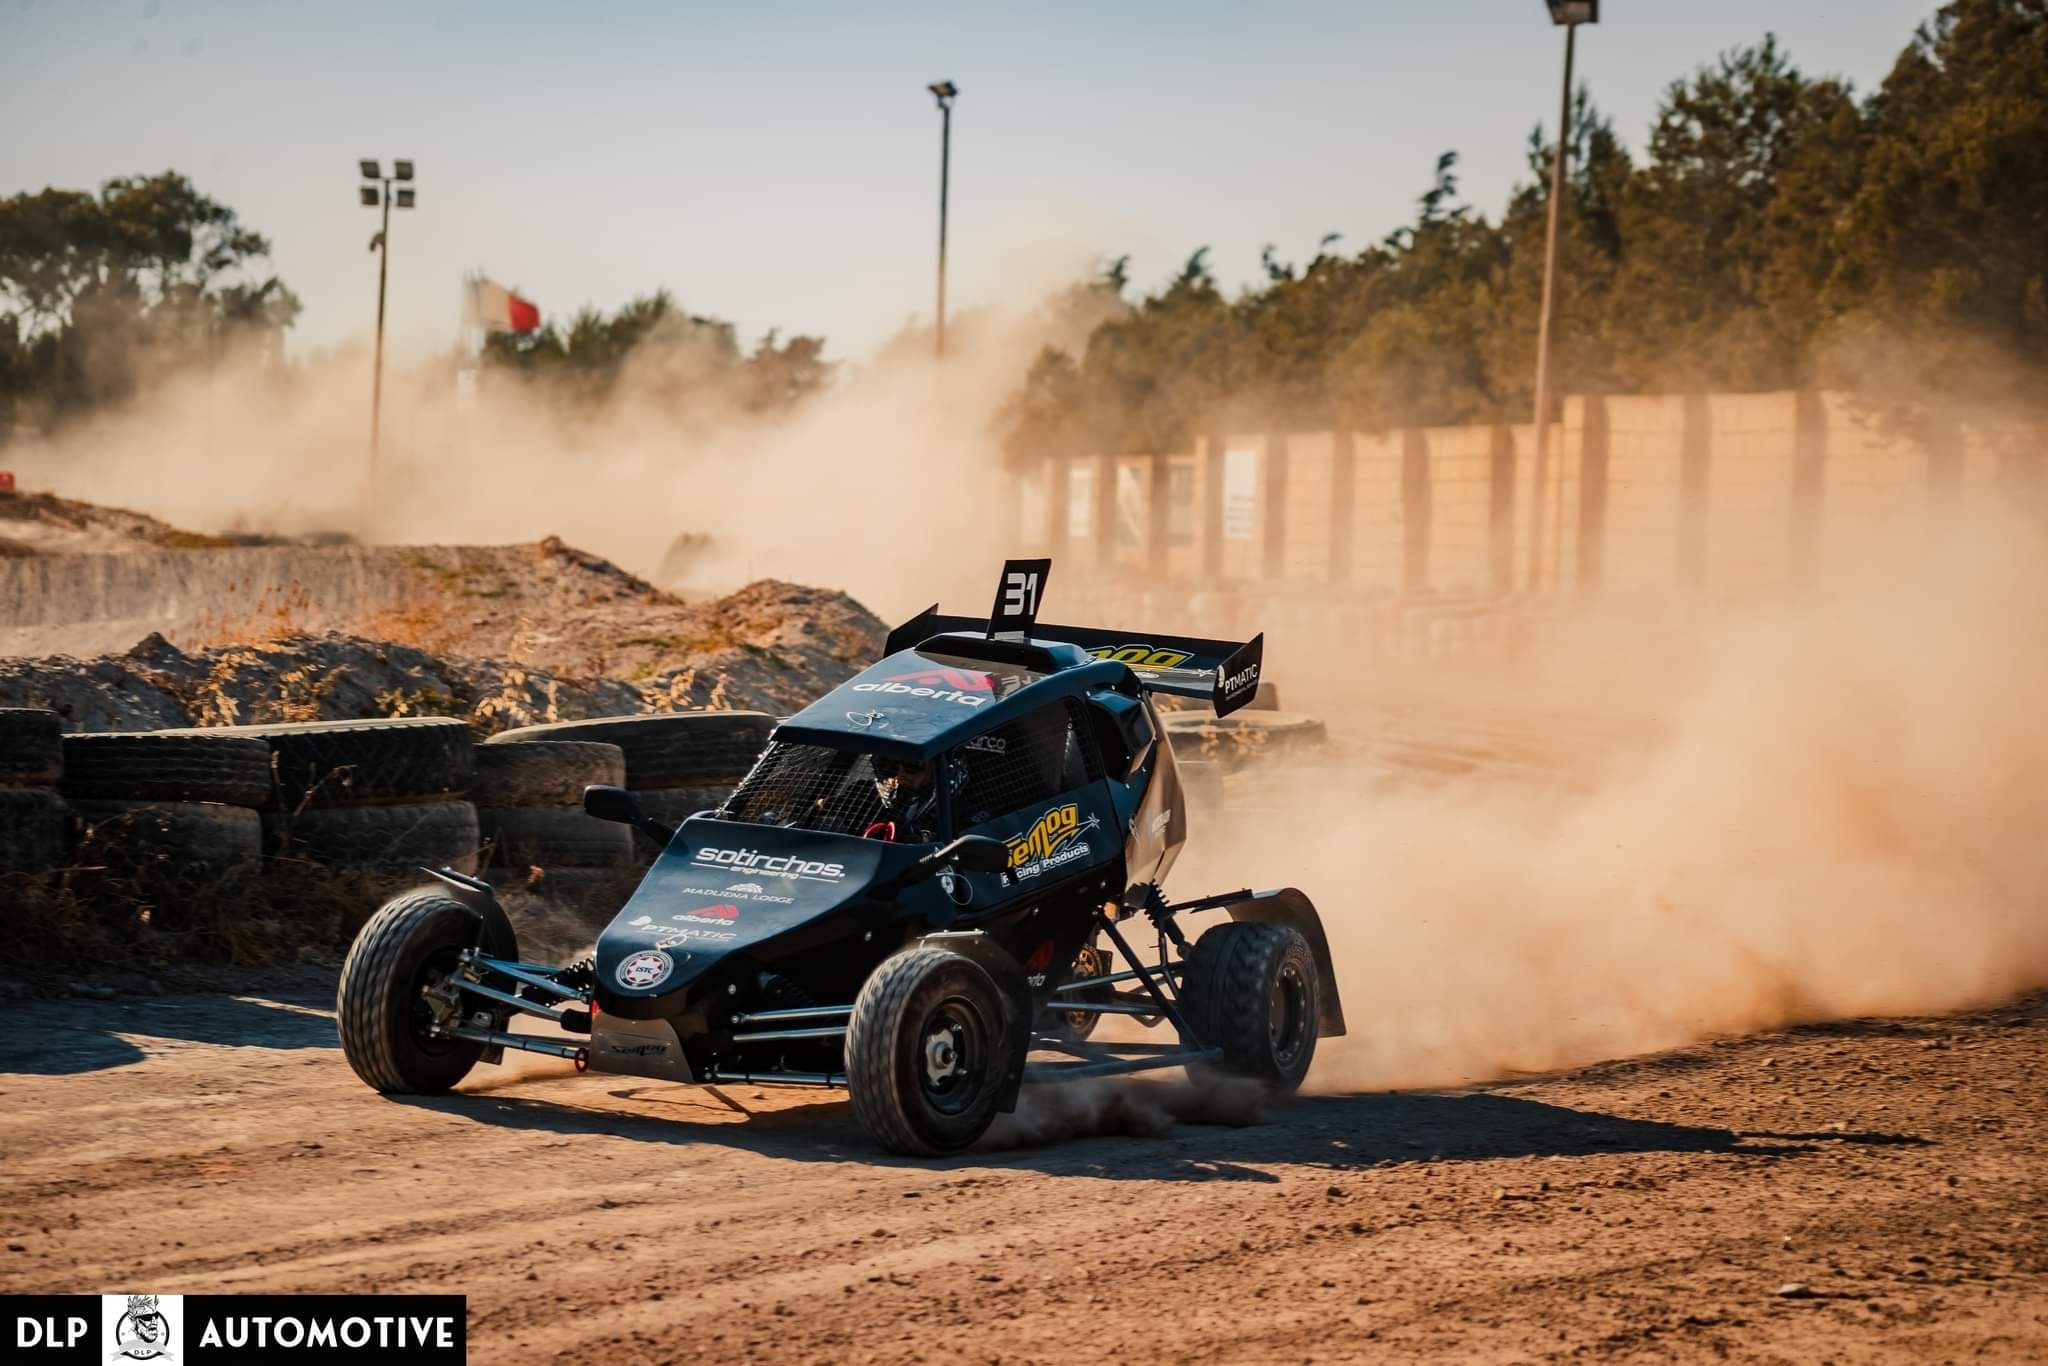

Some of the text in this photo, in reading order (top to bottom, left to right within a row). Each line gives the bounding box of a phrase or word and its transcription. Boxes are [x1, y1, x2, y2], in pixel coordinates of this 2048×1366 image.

[1003, 573, 1039, 616] 31
[1225, 664, 1258, 694] PTMATIC
[852, 681, 988, 707] alberta
[730, 866, 800, 880] engineering
[1001, 845, 1090, 886] Rcing Products
[752, 894, 796, 905] LODGE
[672, 914, 737, 926] alberta
[641, 924, 738, 940] PTMATIC
